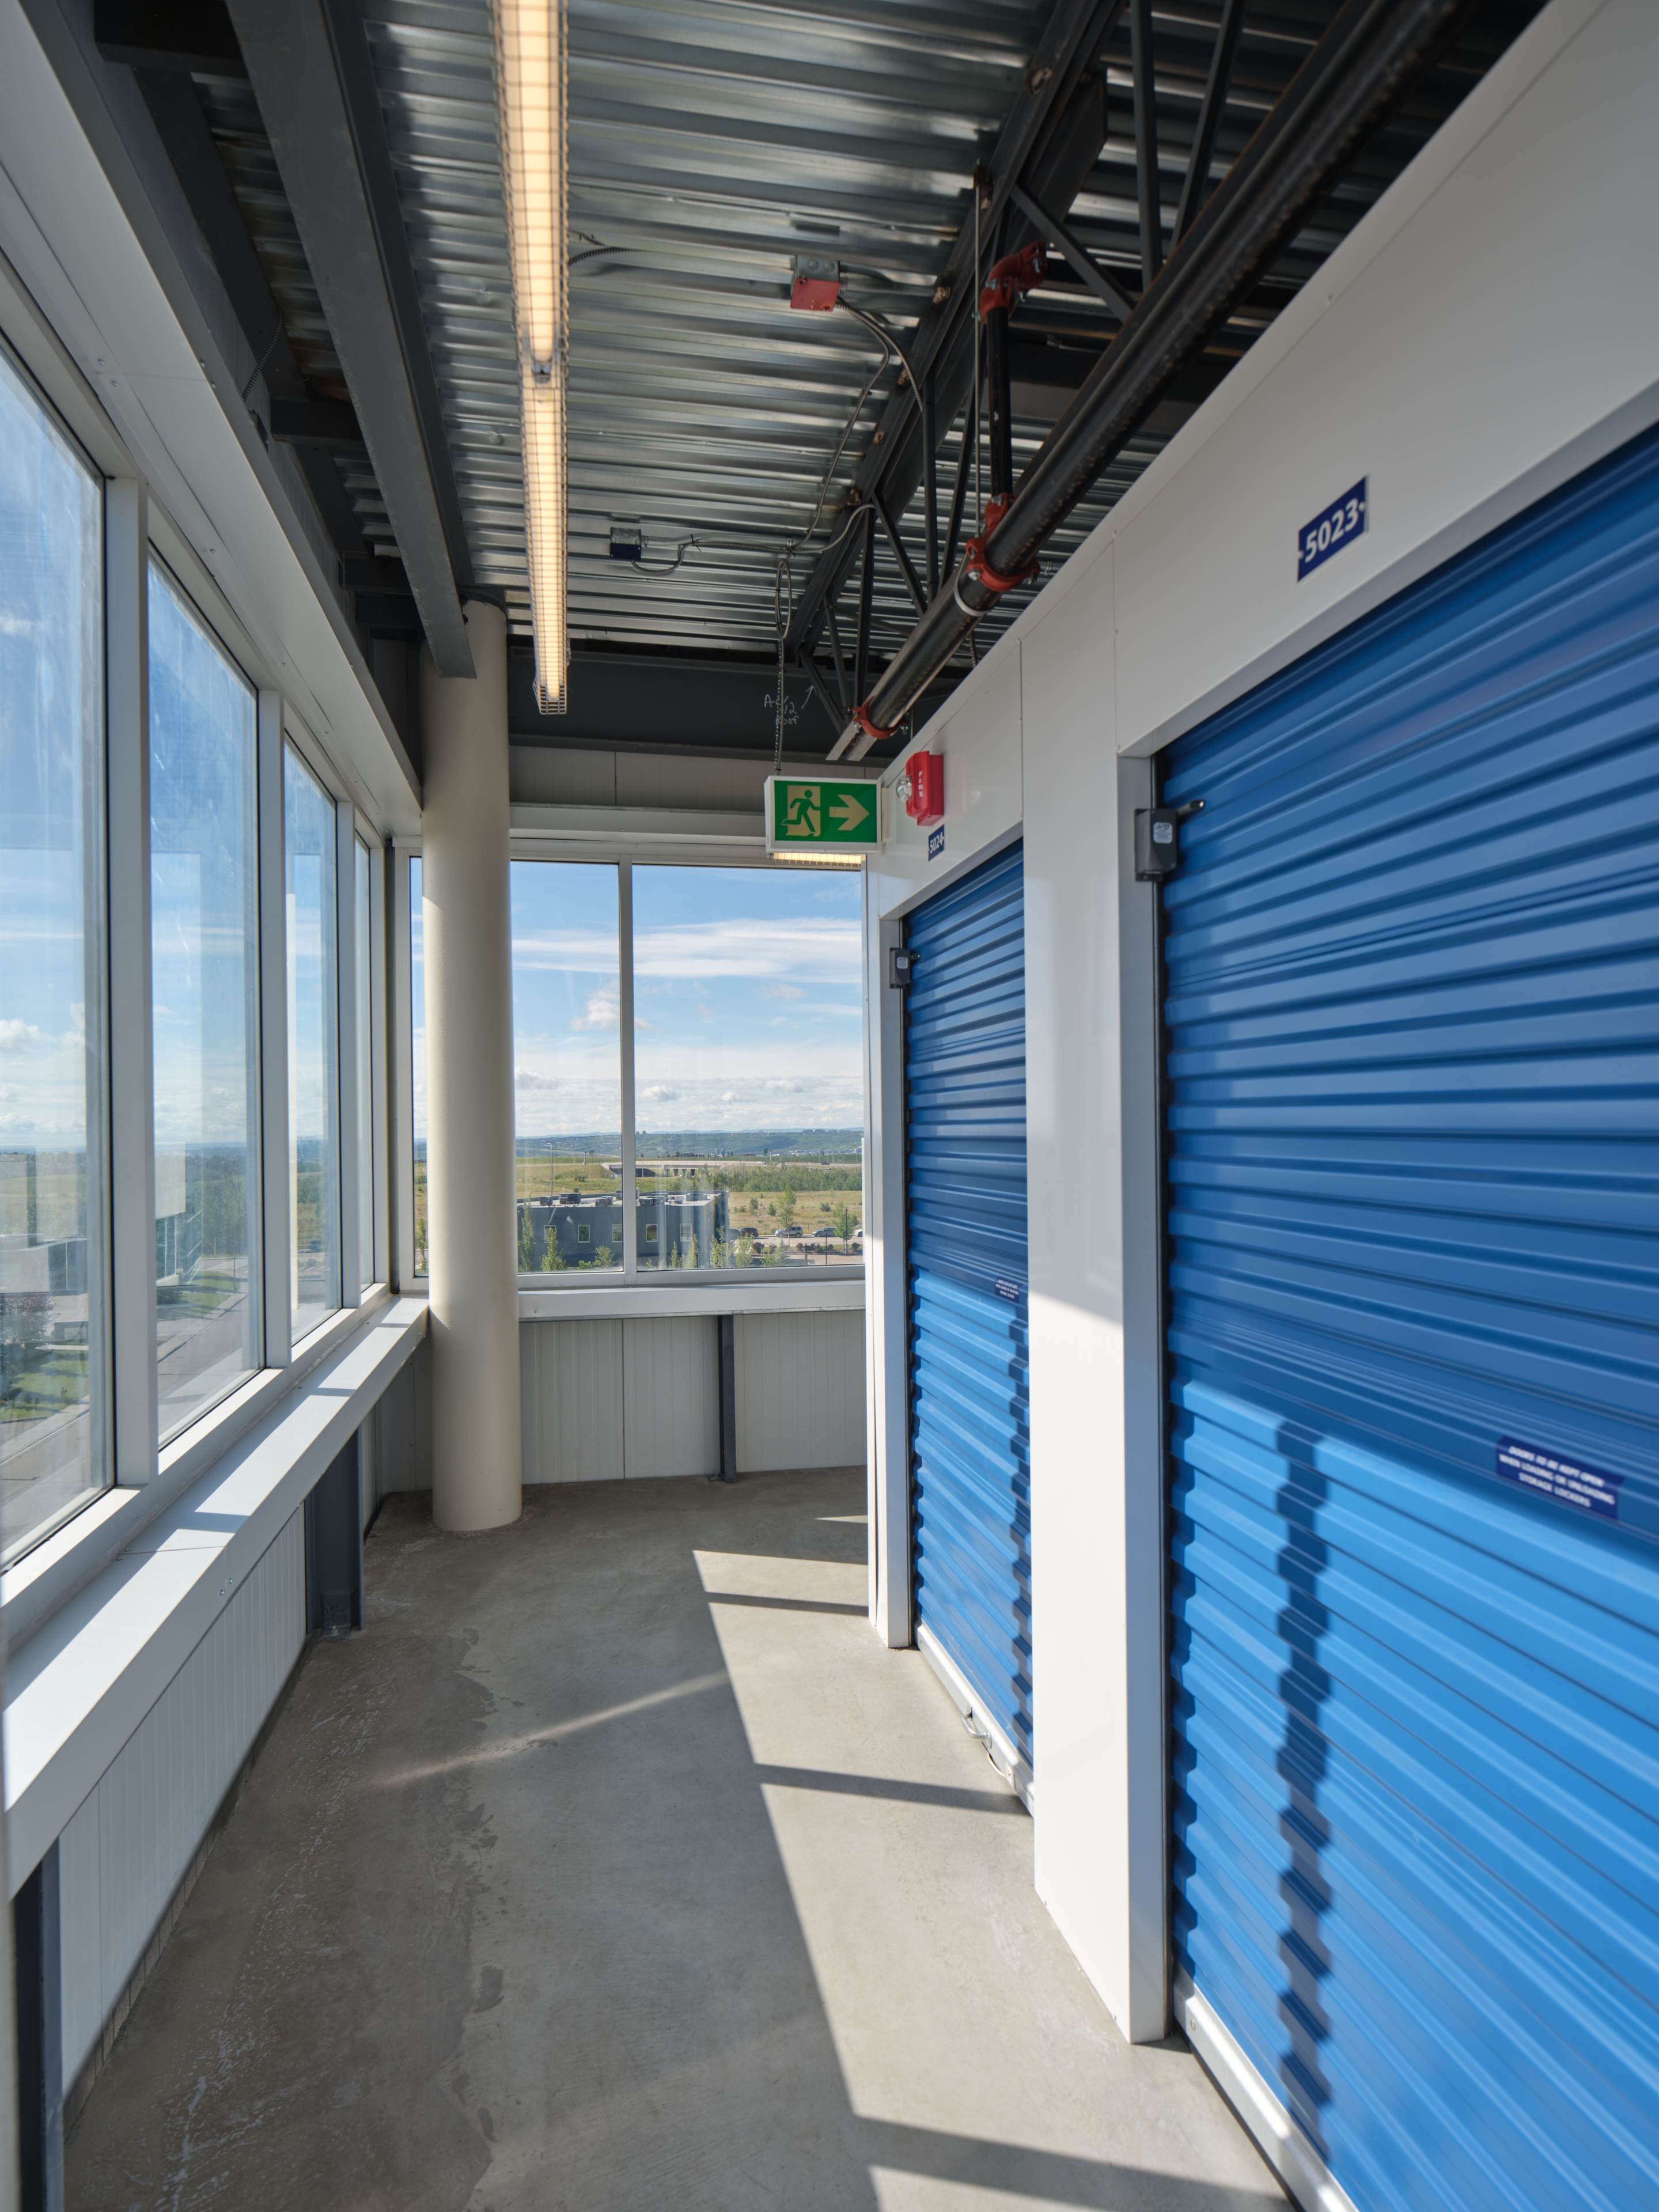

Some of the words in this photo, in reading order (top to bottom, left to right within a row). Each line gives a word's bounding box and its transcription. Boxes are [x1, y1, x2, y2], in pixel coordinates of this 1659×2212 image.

[1305, 498, 1358, 563] 5023
[930, 832, 943, 854] 5024
[1498, 1453, 1521, 1468] WHEN
[1521, 1462, 1554, 1481] LOADING
[1555, 1474, 1567, 1486] OR
[1567, 1479, 1615, 1505] UNLOADING
[1535, 1455, 1547, 1465] TO
[1547, 1460, 1559, 1470] BE
